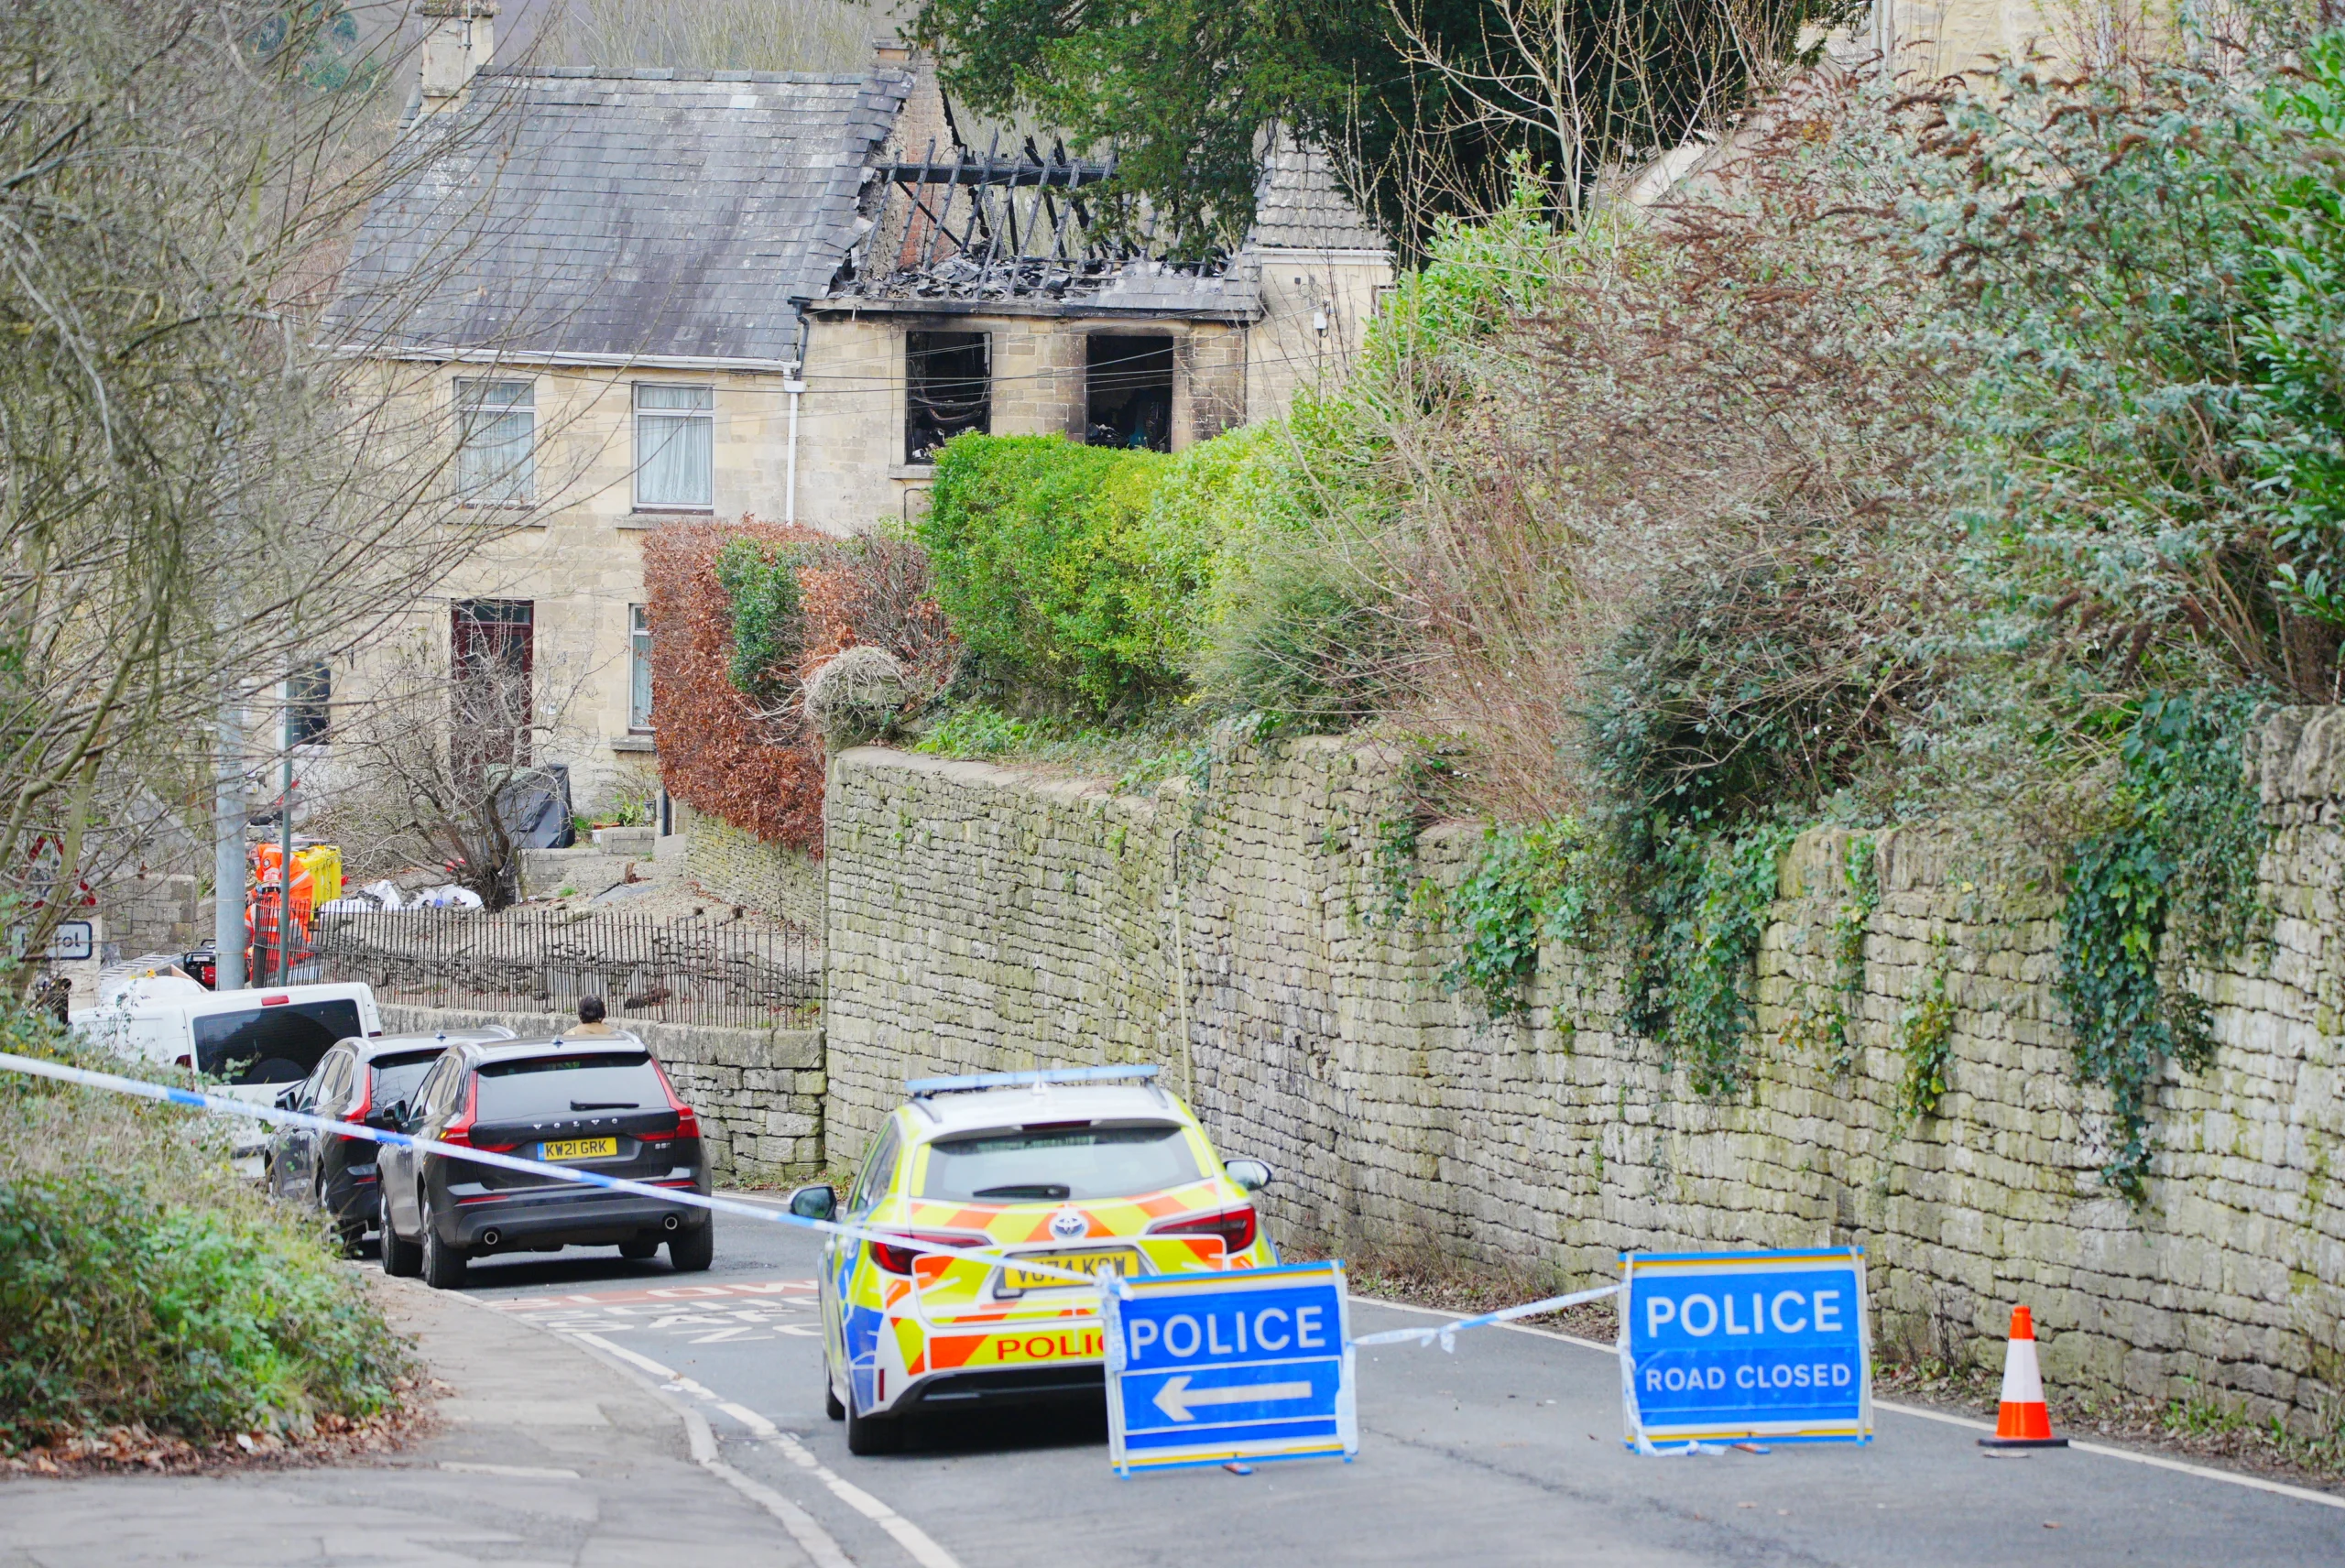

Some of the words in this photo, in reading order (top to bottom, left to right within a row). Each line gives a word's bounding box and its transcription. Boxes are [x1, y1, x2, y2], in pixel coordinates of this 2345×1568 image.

[533, 1117, 618, 1130] VOLVO
[545, 1142, 577, 1157] KW21
[580, 1139, 607, 1155] GRK
[1646, 1290, 1843, 1338] POLICE
[1129, 1305, 1325, 1361] POLICE
[997, 1334, 1104, 1361] POLI
[1645, 1366, 1727, 1392] ROAD
[1735, 1363, 1851, 1389] CLOSED
